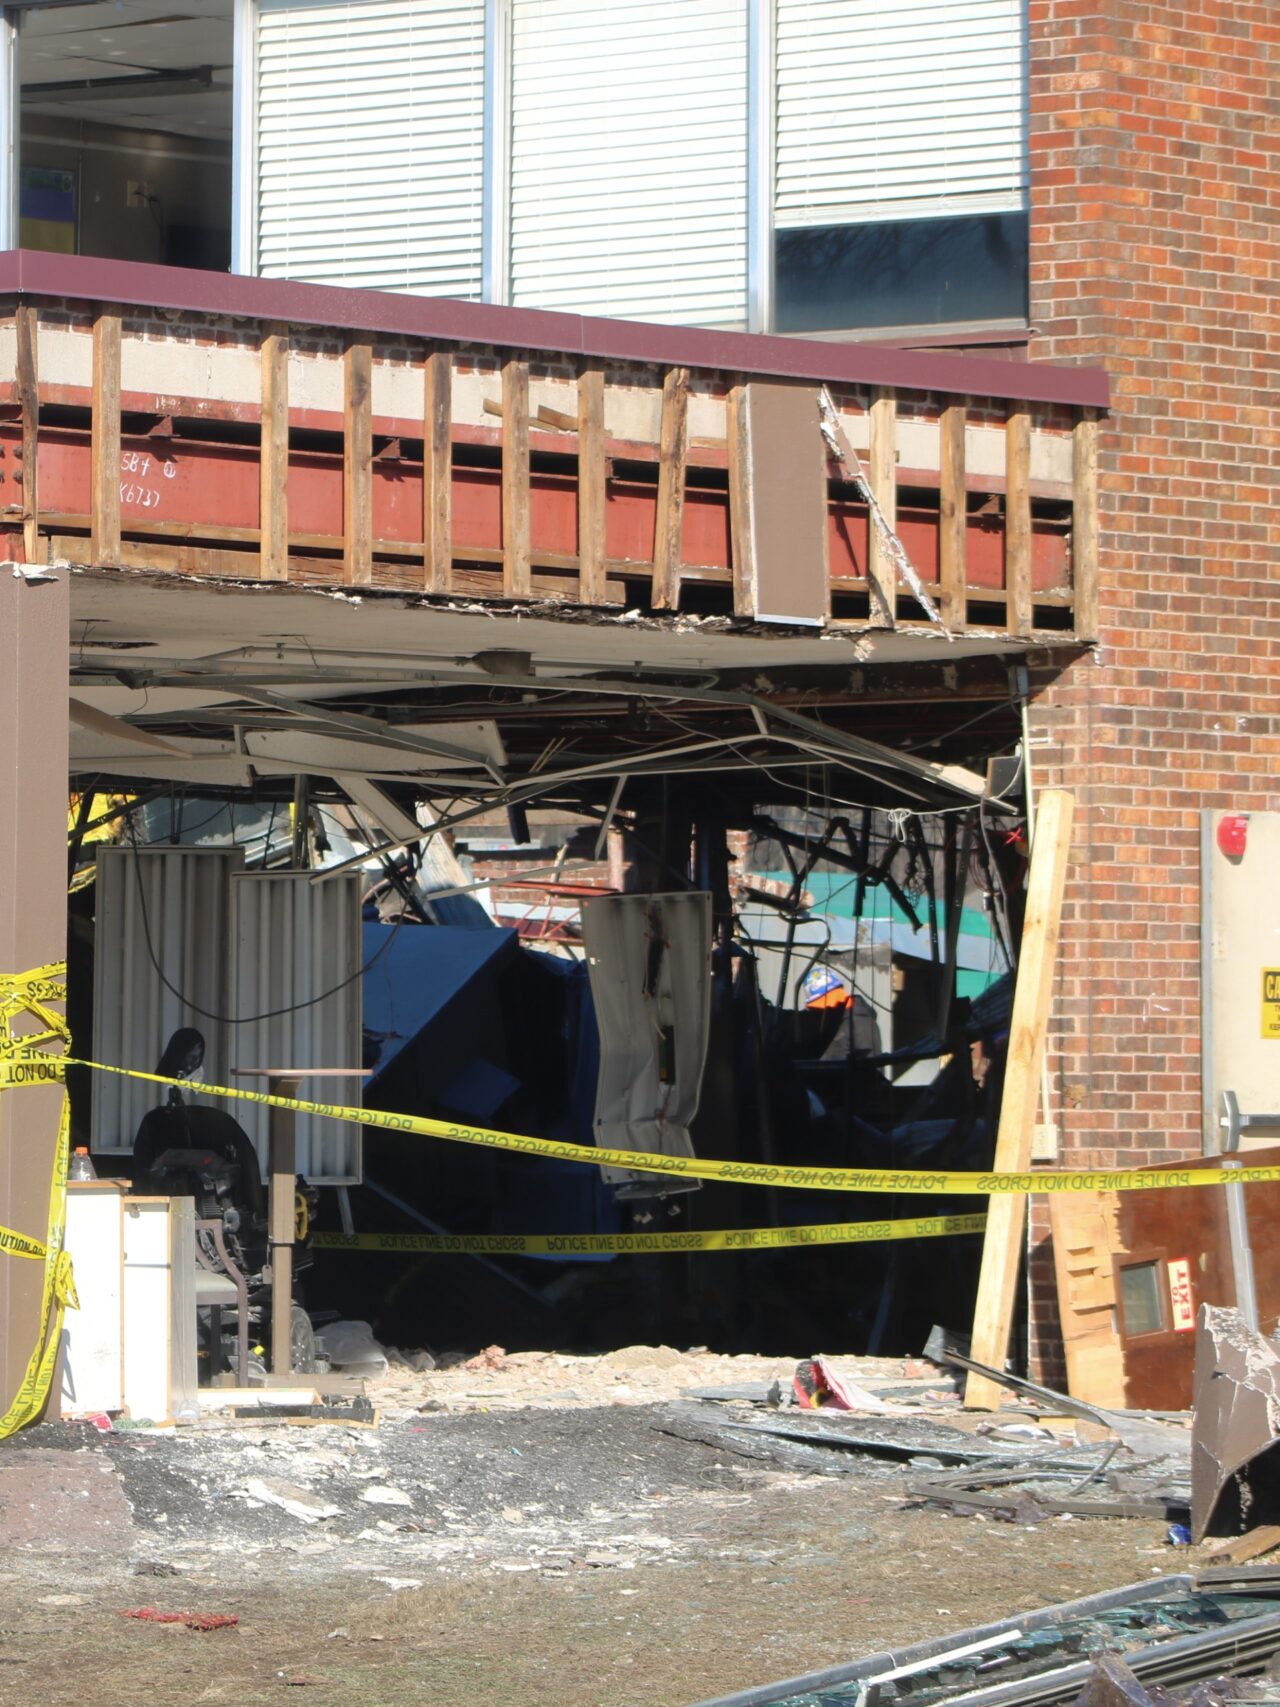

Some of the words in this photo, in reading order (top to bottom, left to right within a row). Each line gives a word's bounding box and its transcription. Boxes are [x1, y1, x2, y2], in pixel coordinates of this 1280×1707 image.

[5, 1065, 34, 1084] NOT
[1172, 1286, 1179, 1307] TO
[1177, 1268, 1191, 1321] EXIT
